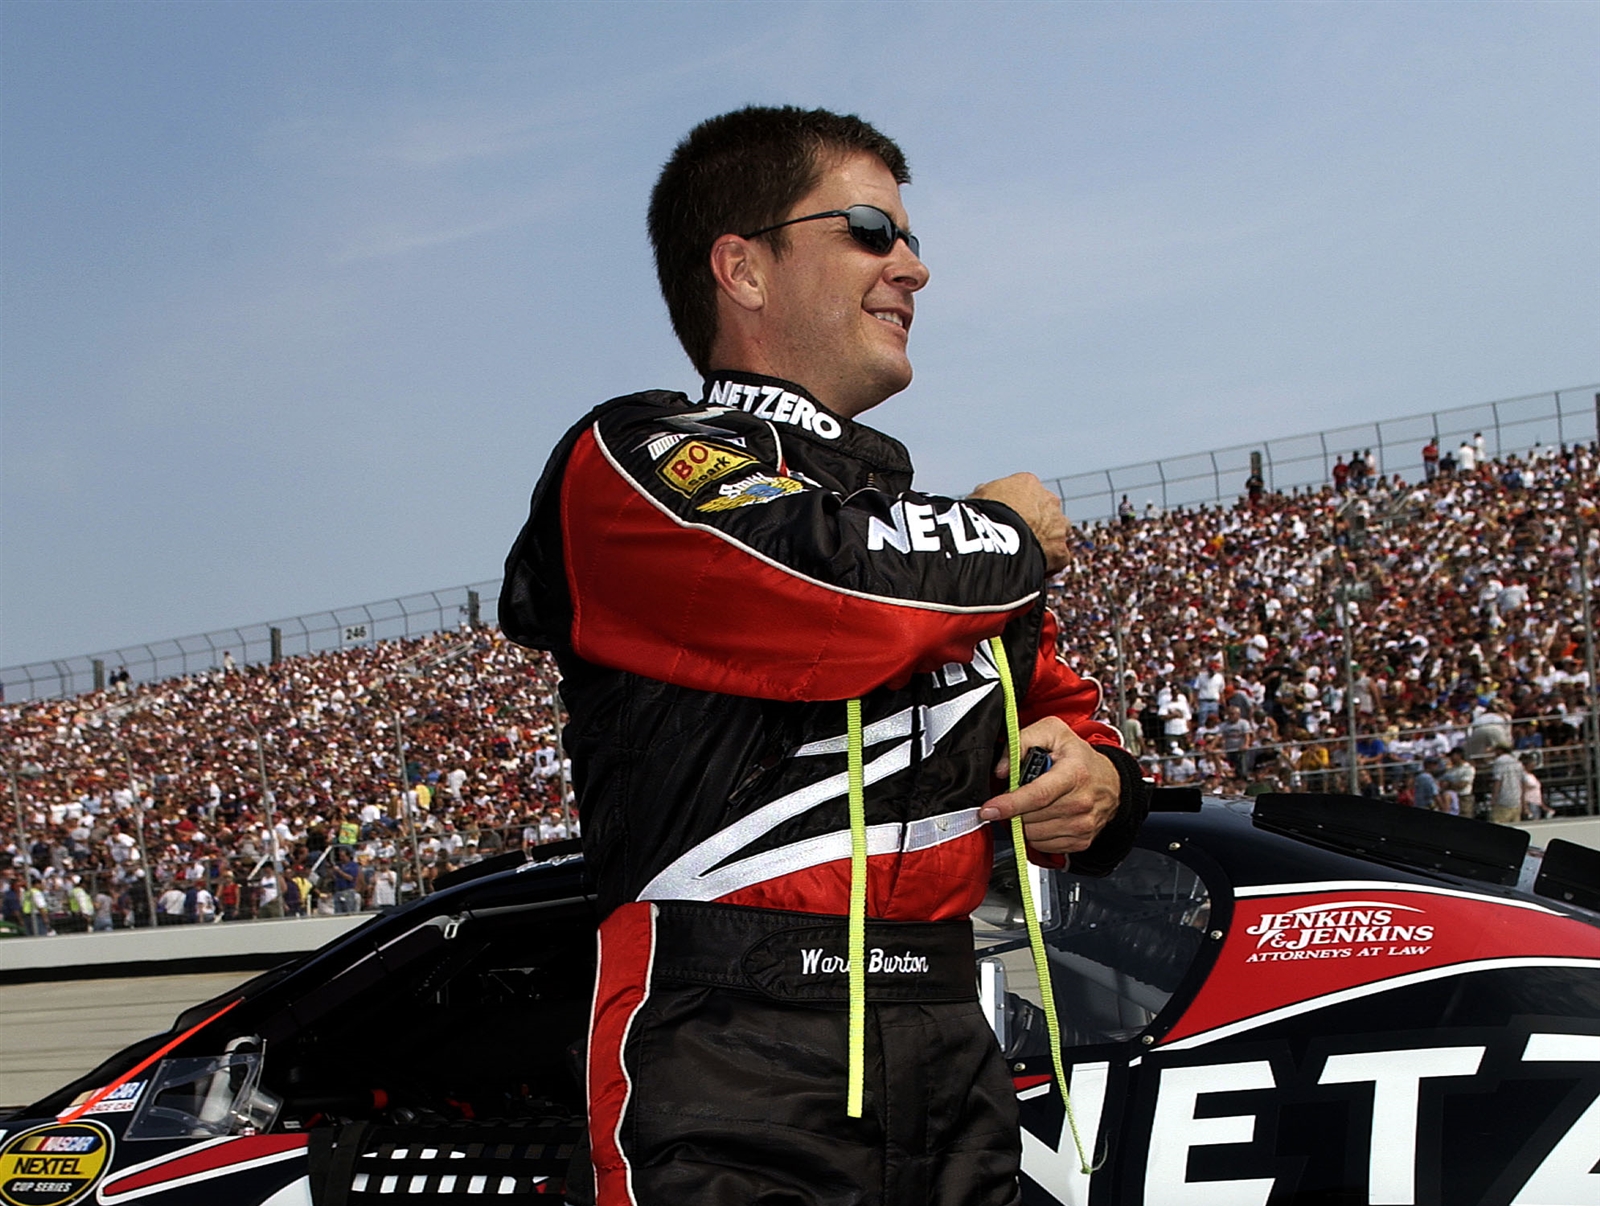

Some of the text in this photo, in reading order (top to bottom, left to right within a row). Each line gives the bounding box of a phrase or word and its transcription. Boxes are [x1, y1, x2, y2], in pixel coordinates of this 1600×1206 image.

[708, 380, 842, 440] NETZERO
[1246, 910, 1392, 935] JENKINS
[1286, 926, 1434, 950] JENKINS
[801, 948, 929, 974] War Burton
[1246, 946, 1432, 963] ATTORNEYS AT LAW
[41, 1136, 96, 1151] NASCAR
[13, 1157, 84, 1175] NEXTEL
[12, 1182, 72, 1192] CUP SERIES
